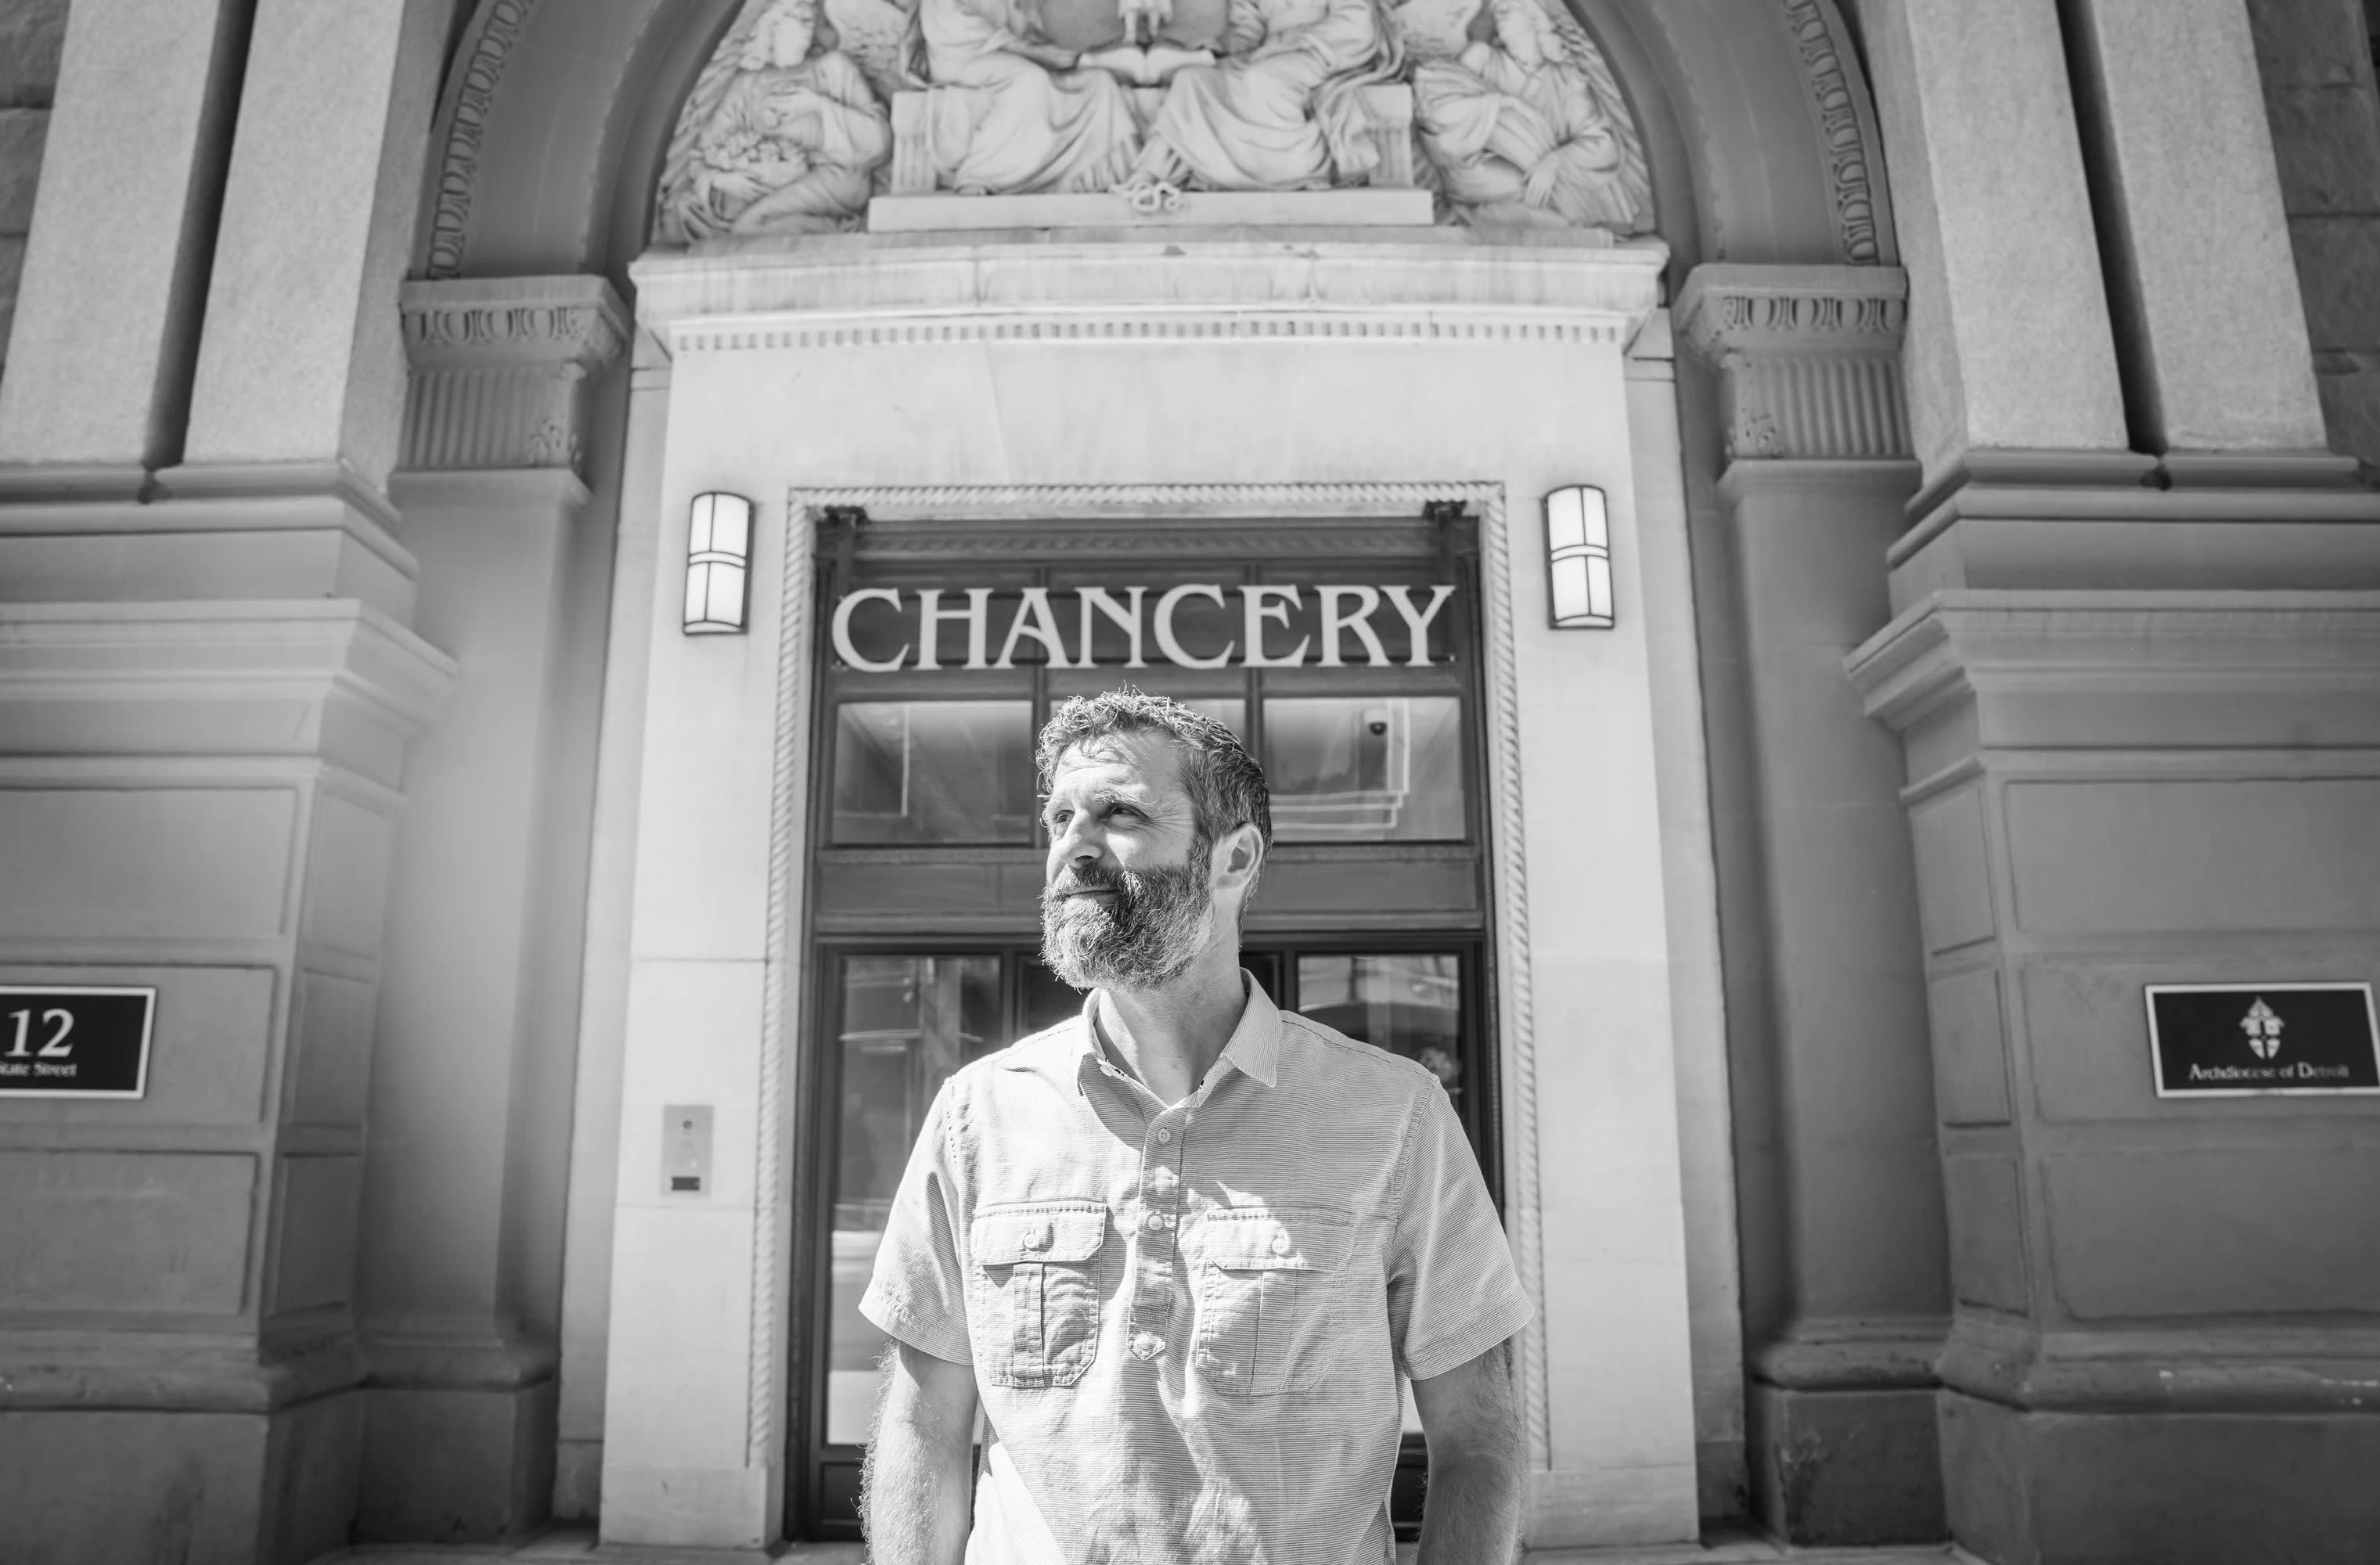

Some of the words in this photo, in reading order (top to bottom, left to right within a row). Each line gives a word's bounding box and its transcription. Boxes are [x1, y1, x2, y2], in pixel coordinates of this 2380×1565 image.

[830, 584, 1456, 673] CHANCERY
[4, 1008, 74, 1056] 12
[34, 1062, 77, 1077] Street
[2189, 1063, 2276, 1080] Archdiocese
[2279, 1065, 2294, 1078] of
[2298, 1061, 2349, 1078] Detroit
